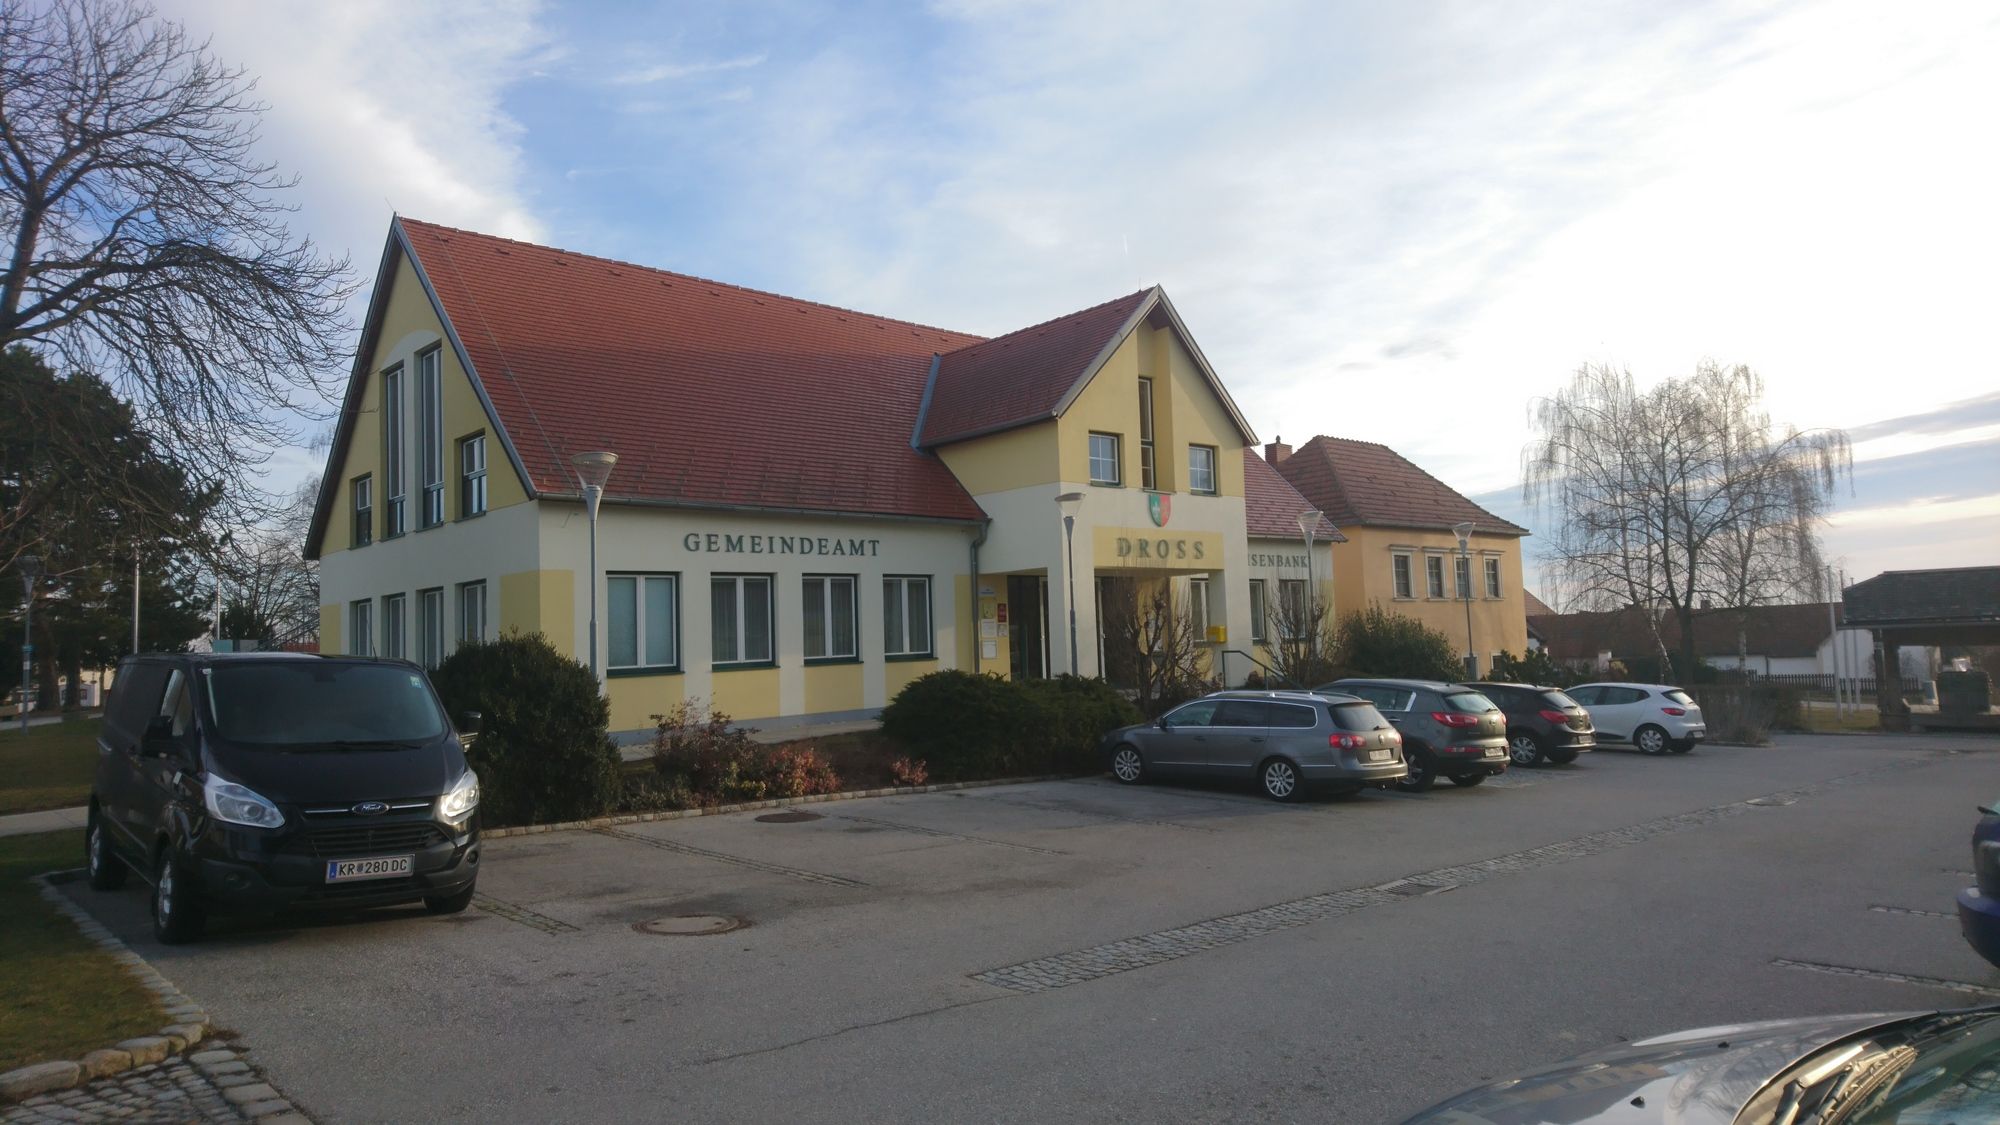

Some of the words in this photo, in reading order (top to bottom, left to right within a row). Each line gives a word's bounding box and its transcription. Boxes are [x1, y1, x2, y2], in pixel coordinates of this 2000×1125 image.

[684, 533, 880, 556] GEMEINDEAMT
[1116, 537, 1204, 559] DROSS
[339, 863, 356, 876] KR
[365, 861, 389, 873] 280
